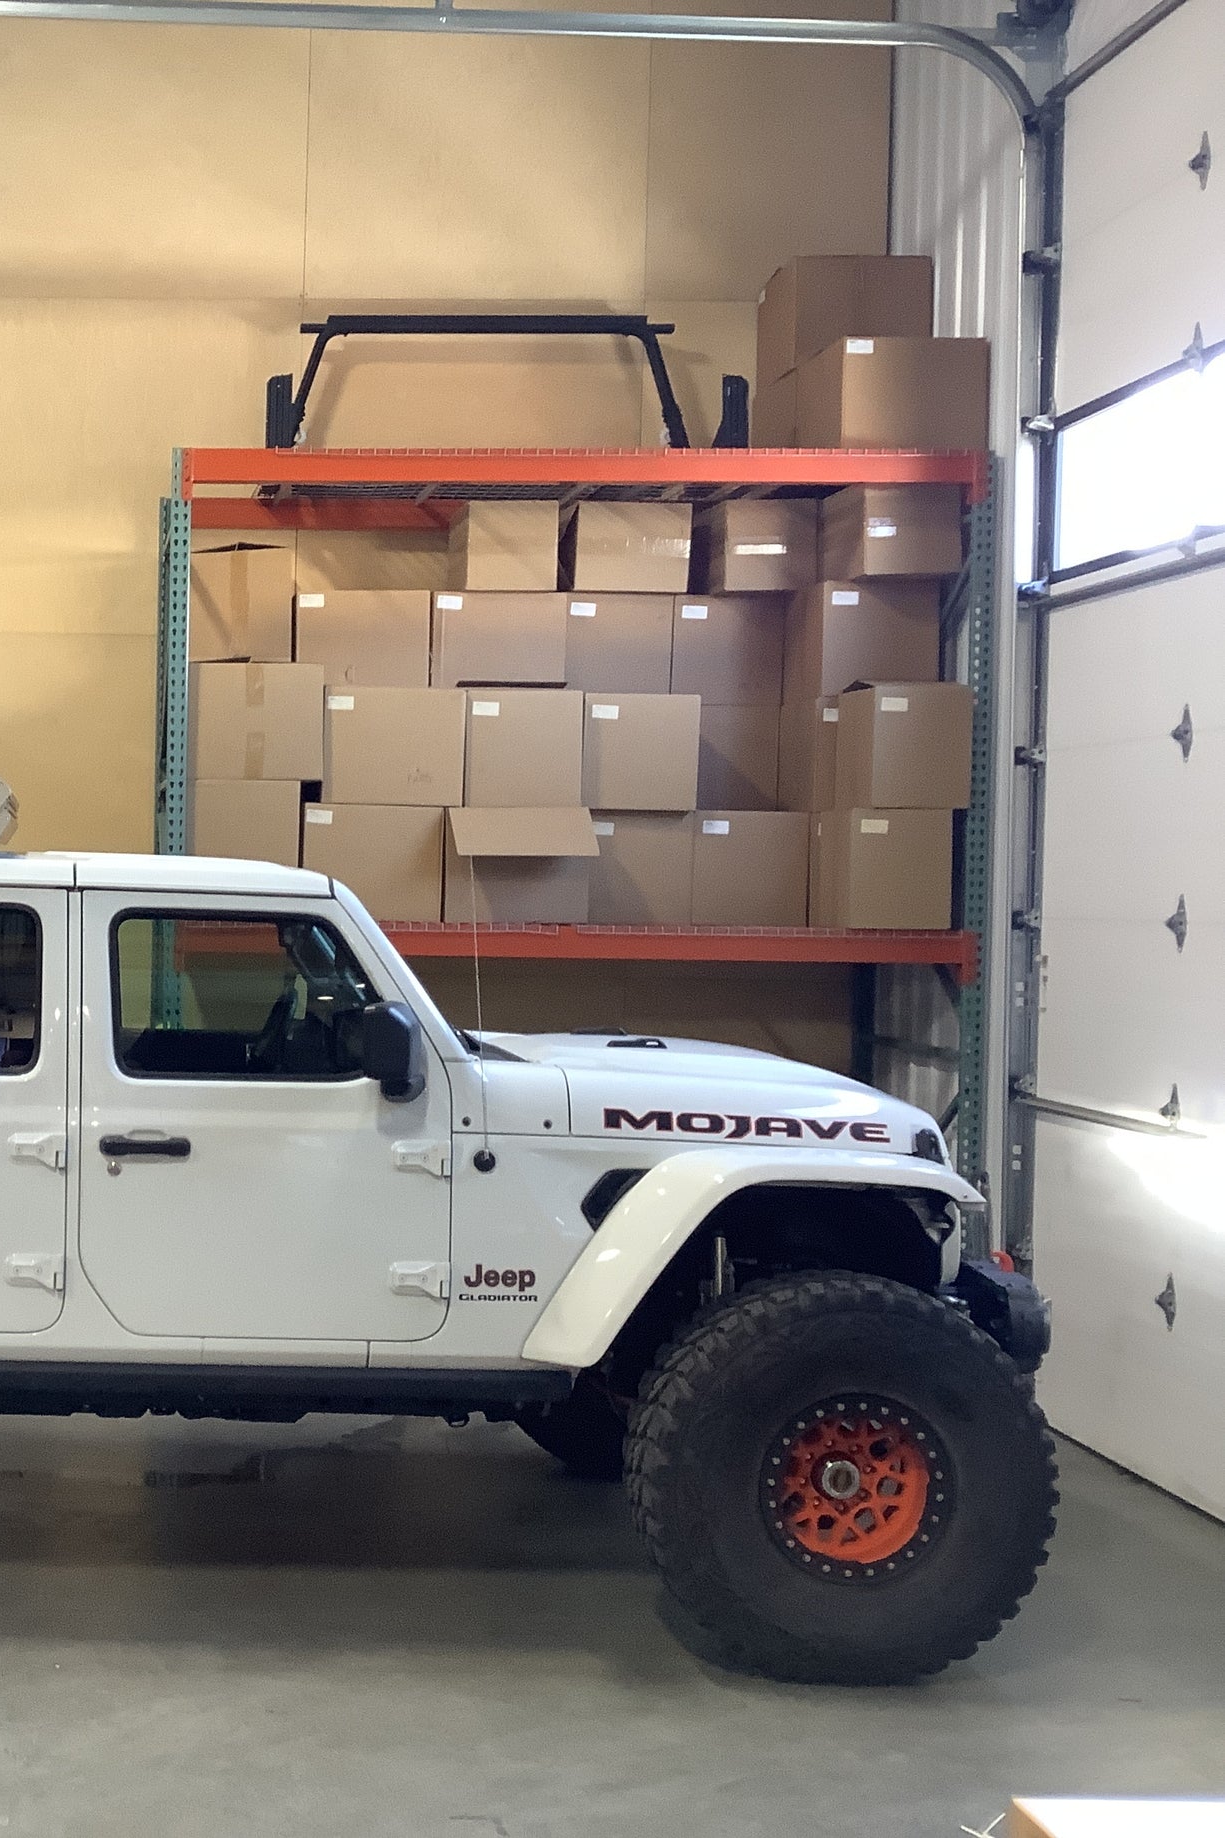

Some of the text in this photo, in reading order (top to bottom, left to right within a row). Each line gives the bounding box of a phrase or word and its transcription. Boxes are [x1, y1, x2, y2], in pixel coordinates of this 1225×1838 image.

[603, 1107, 891, 1143] MOJAVE
[463, 1263, 536, 1292] Jeep
[458, 1293, 538, 1302] GLADIATOR
